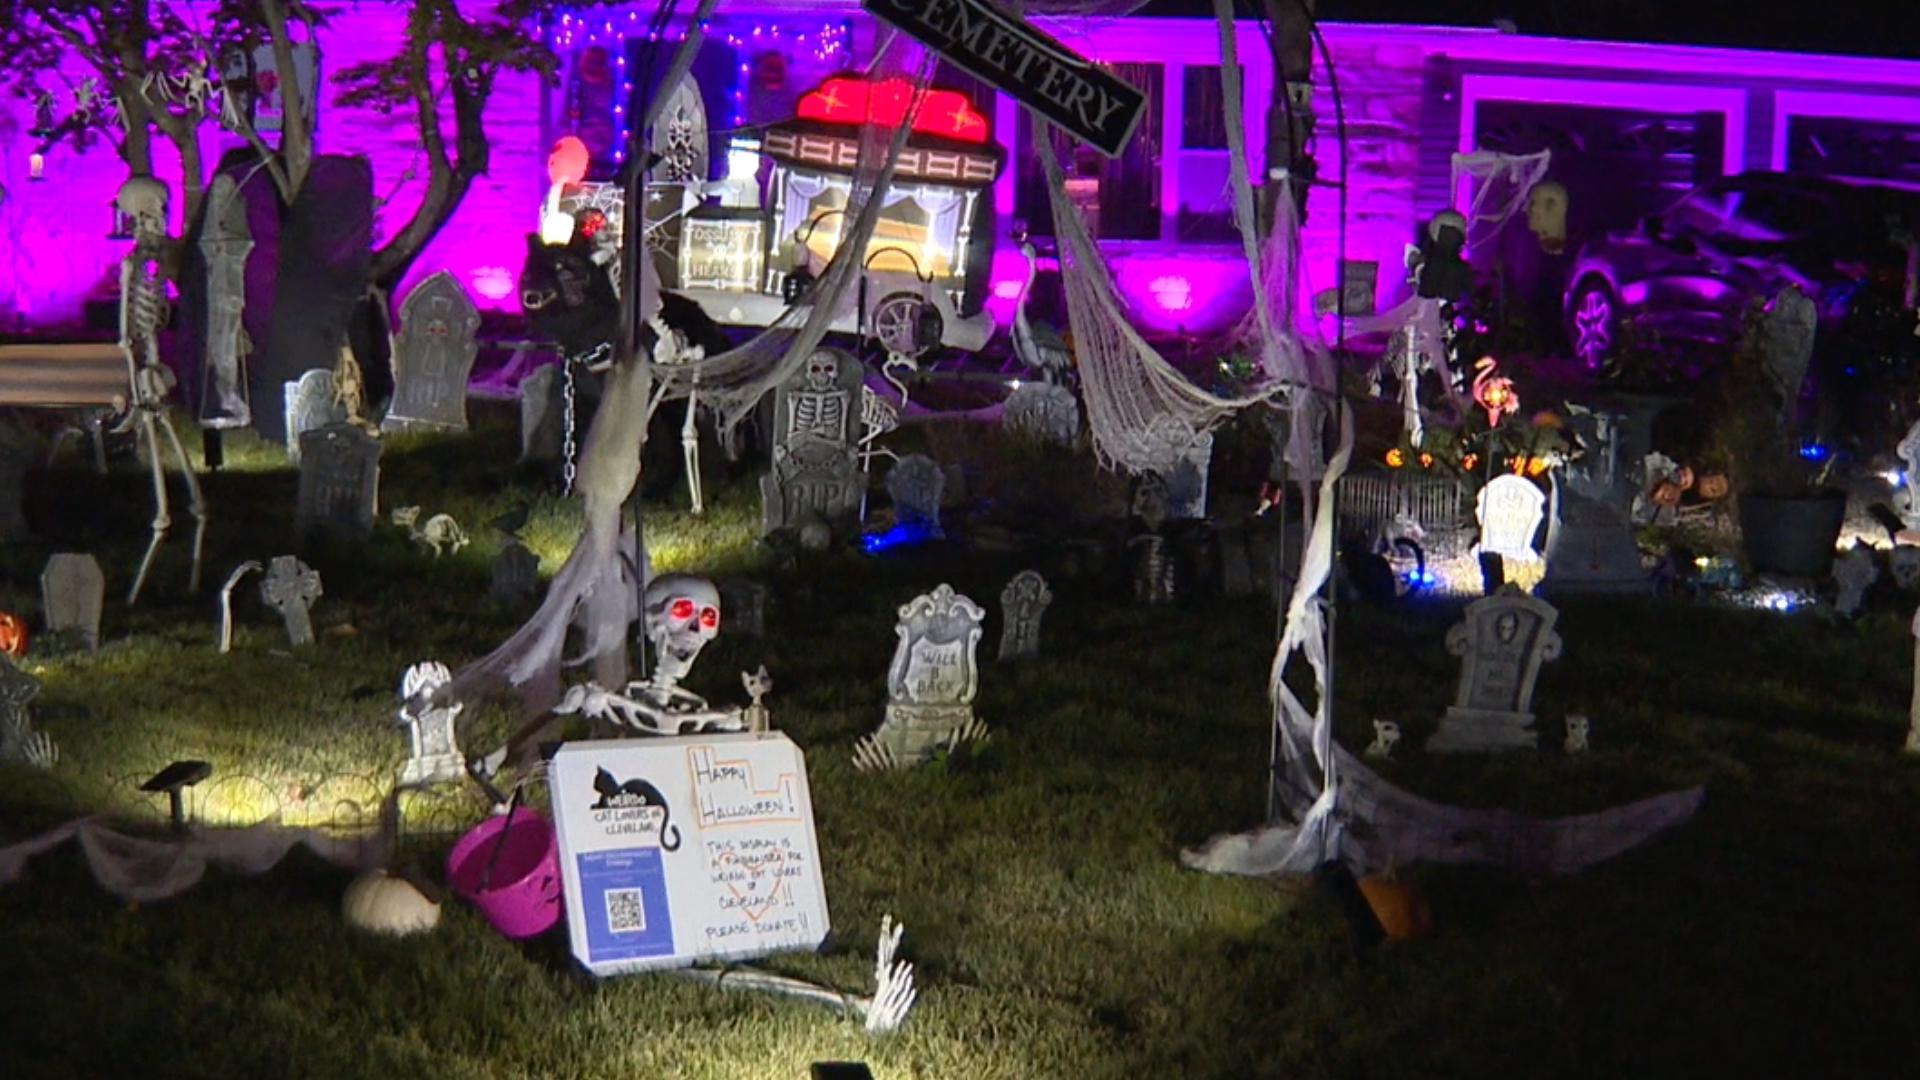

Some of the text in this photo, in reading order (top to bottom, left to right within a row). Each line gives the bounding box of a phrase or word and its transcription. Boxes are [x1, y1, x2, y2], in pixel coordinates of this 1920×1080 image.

[694, 227, 749, 242] OSSU
[917, 680, 954, 694] BACK
[693, 750, 748, 790] HAPPY
[594, 809, 612, 823] CAT
[706, 840, 735, 854] THIS
